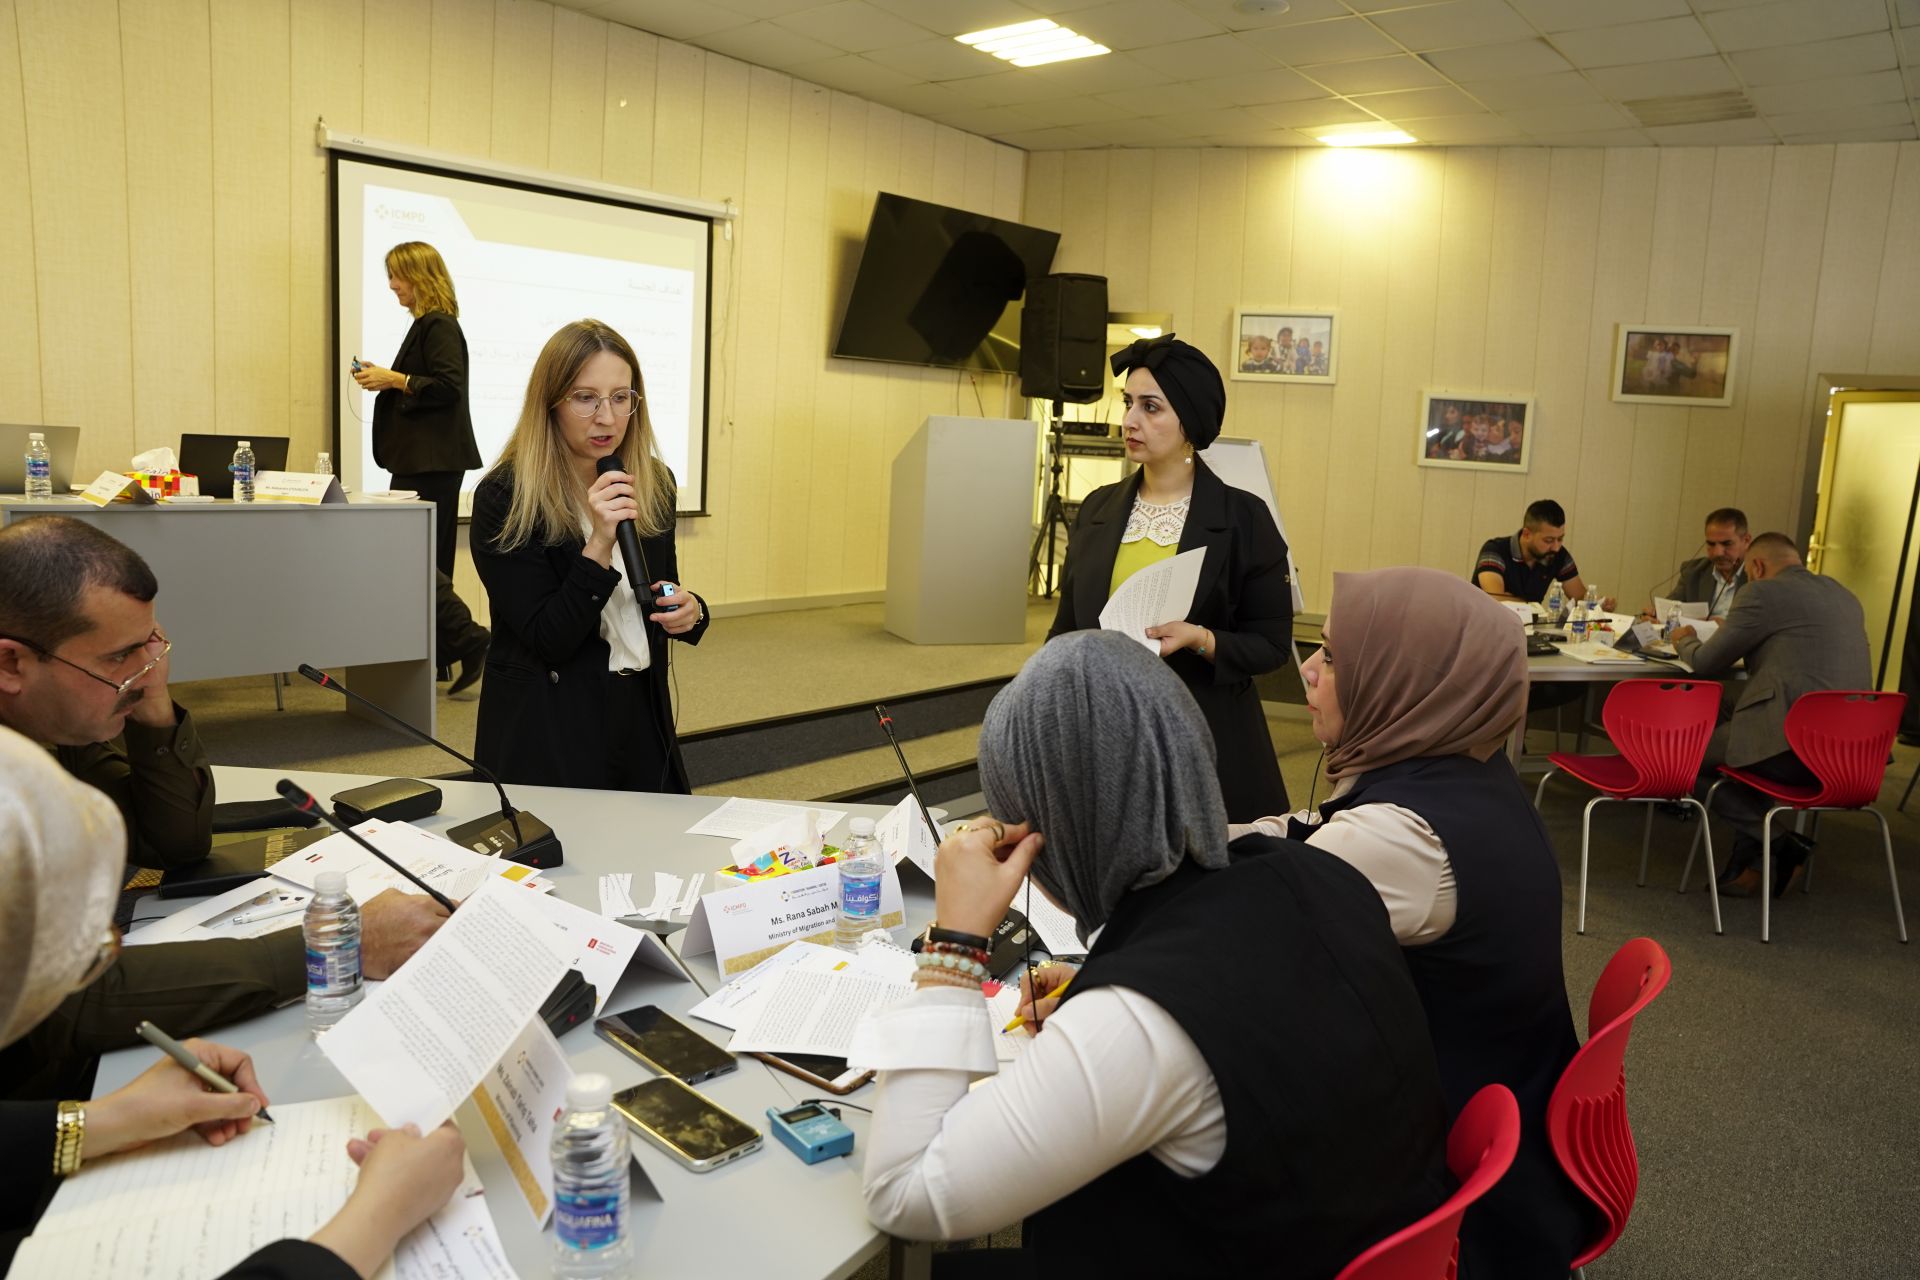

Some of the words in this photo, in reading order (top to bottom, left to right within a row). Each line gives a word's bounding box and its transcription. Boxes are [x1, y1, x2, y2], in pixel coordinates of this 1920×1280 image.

[391, 209, 425, 222] ICMPD
[771, 917, 785, 926] Ms.
[786, 911, 806, 922] Rana
[806, 904, 830, 917] Sabah
[768, 930, 791, 941] Ministry
[799, 921, 825, 932] Migration
[825, 917, 836, 926] and
